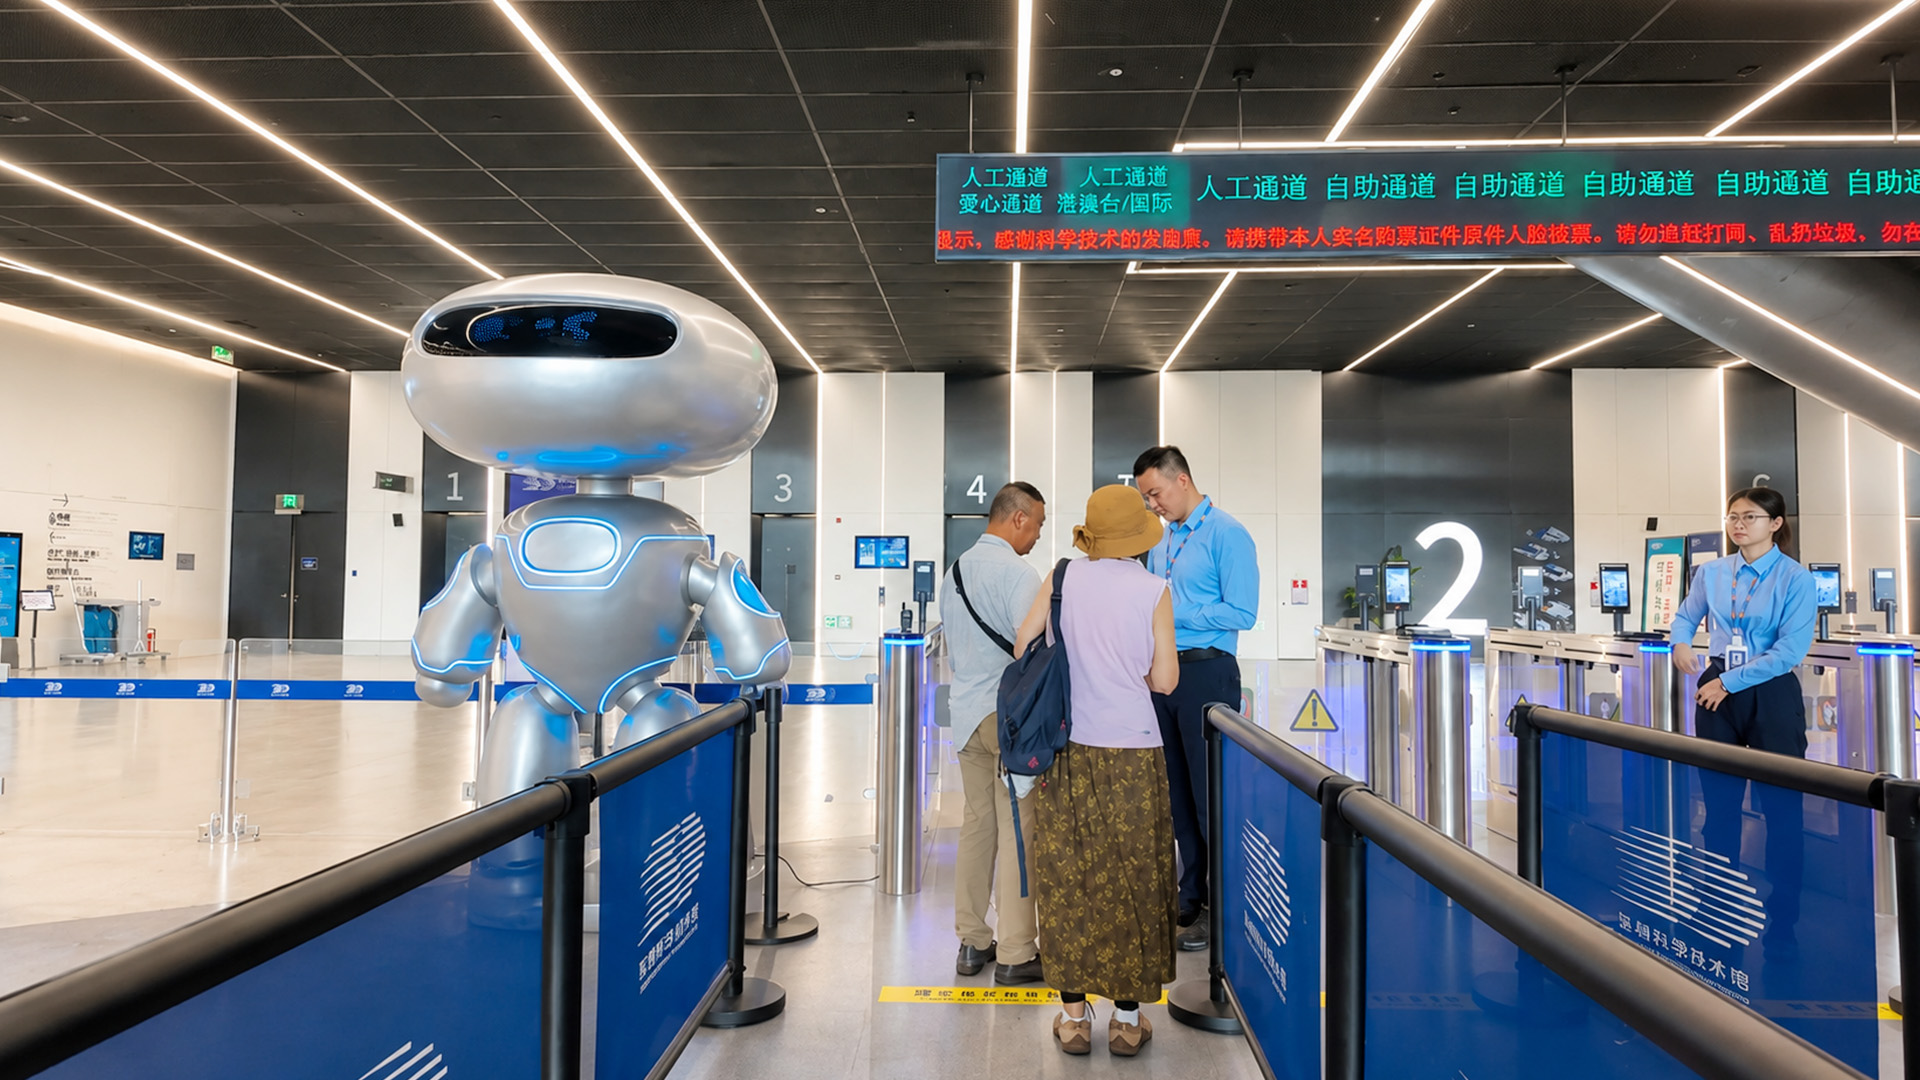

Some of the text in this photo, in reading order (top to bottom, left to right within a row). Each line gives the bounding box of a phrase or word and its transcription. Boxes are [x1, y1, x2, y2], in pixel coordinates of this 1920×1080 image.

[962, 165, 1169, 188] 人工通道 人工通道
[1196, 173, 1308, 202] 人工通道
[1327, 172, 1436, 201] 自助通道
[1455, 170, 1565, 200] 自助通道
[1584, 169, 1695, 198] 自助通道
[1717, 168, 1830, 197] 自助通道
[446, 472, 463, 501] 1
[774, 473, 793, 503] 3
[966, 474, 988, 504] 4
[1415, 521, 1488, 636] 2
